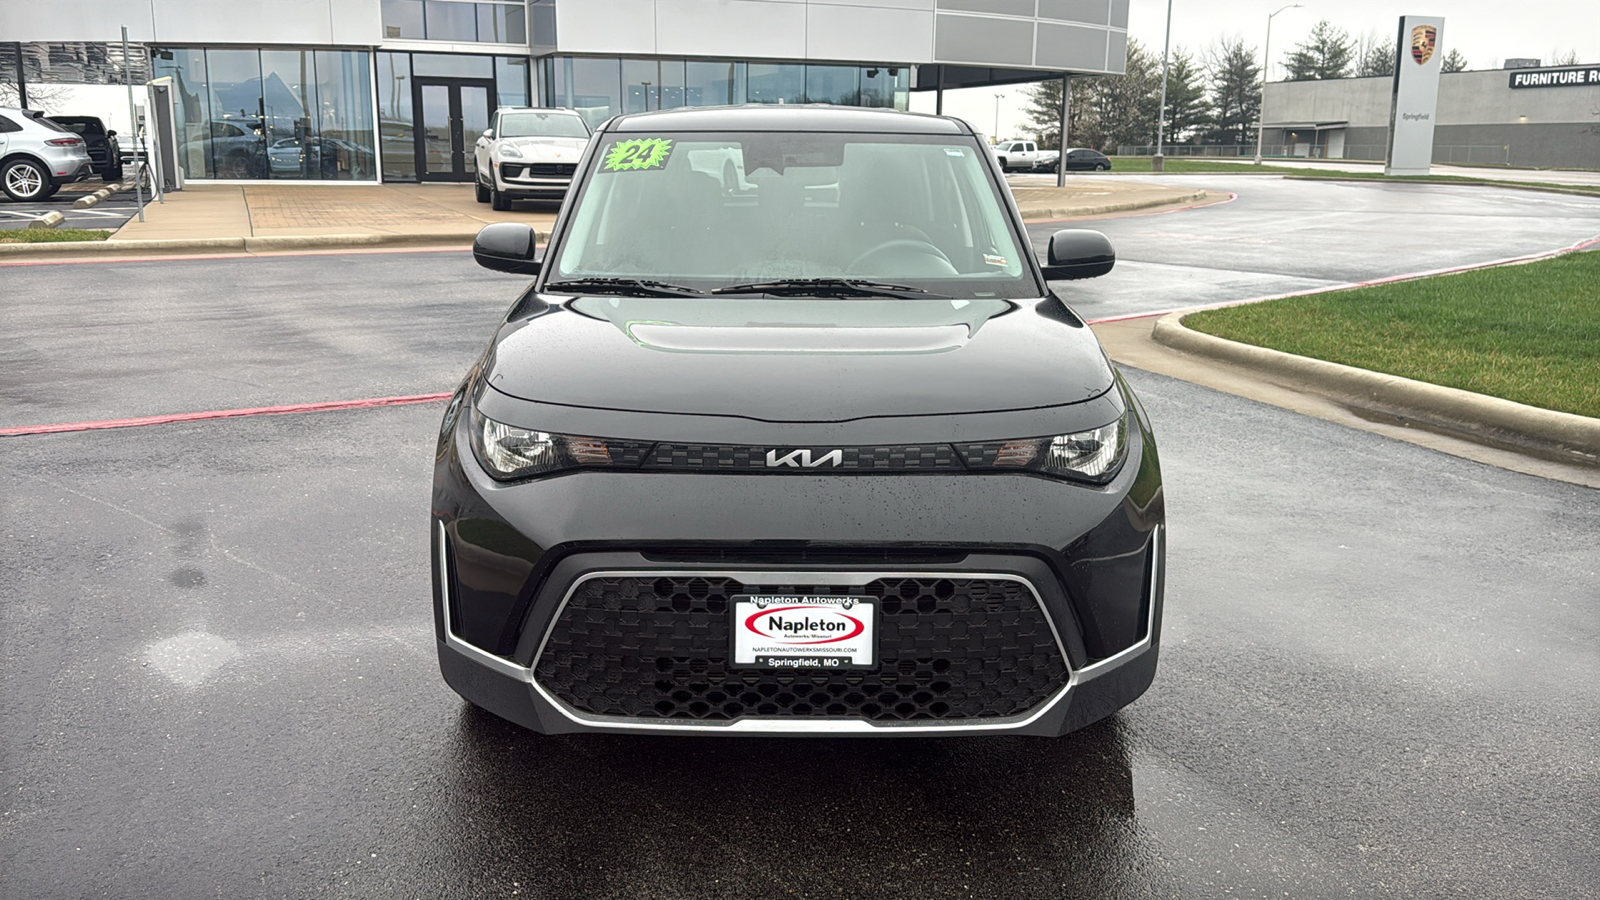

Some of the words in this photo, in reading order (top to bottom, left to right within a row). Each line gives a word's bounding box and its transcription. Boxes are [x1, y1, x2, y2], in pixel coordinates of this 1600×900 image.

[1514, 71, 1585, 86] FURNITURE
[1588, 70, 1600, 83] R
[1402, 112, 1430, 122] Springfield
[618, 144, 656, 164] 24
[750, 596, 799, 605] Napleton
[801, 596, 860, 605] Autowerks
[768, 616, 846, 634] Napleton
[768, 658, 821, 668] Springfield,
[823, 658, 840, 667] MO
